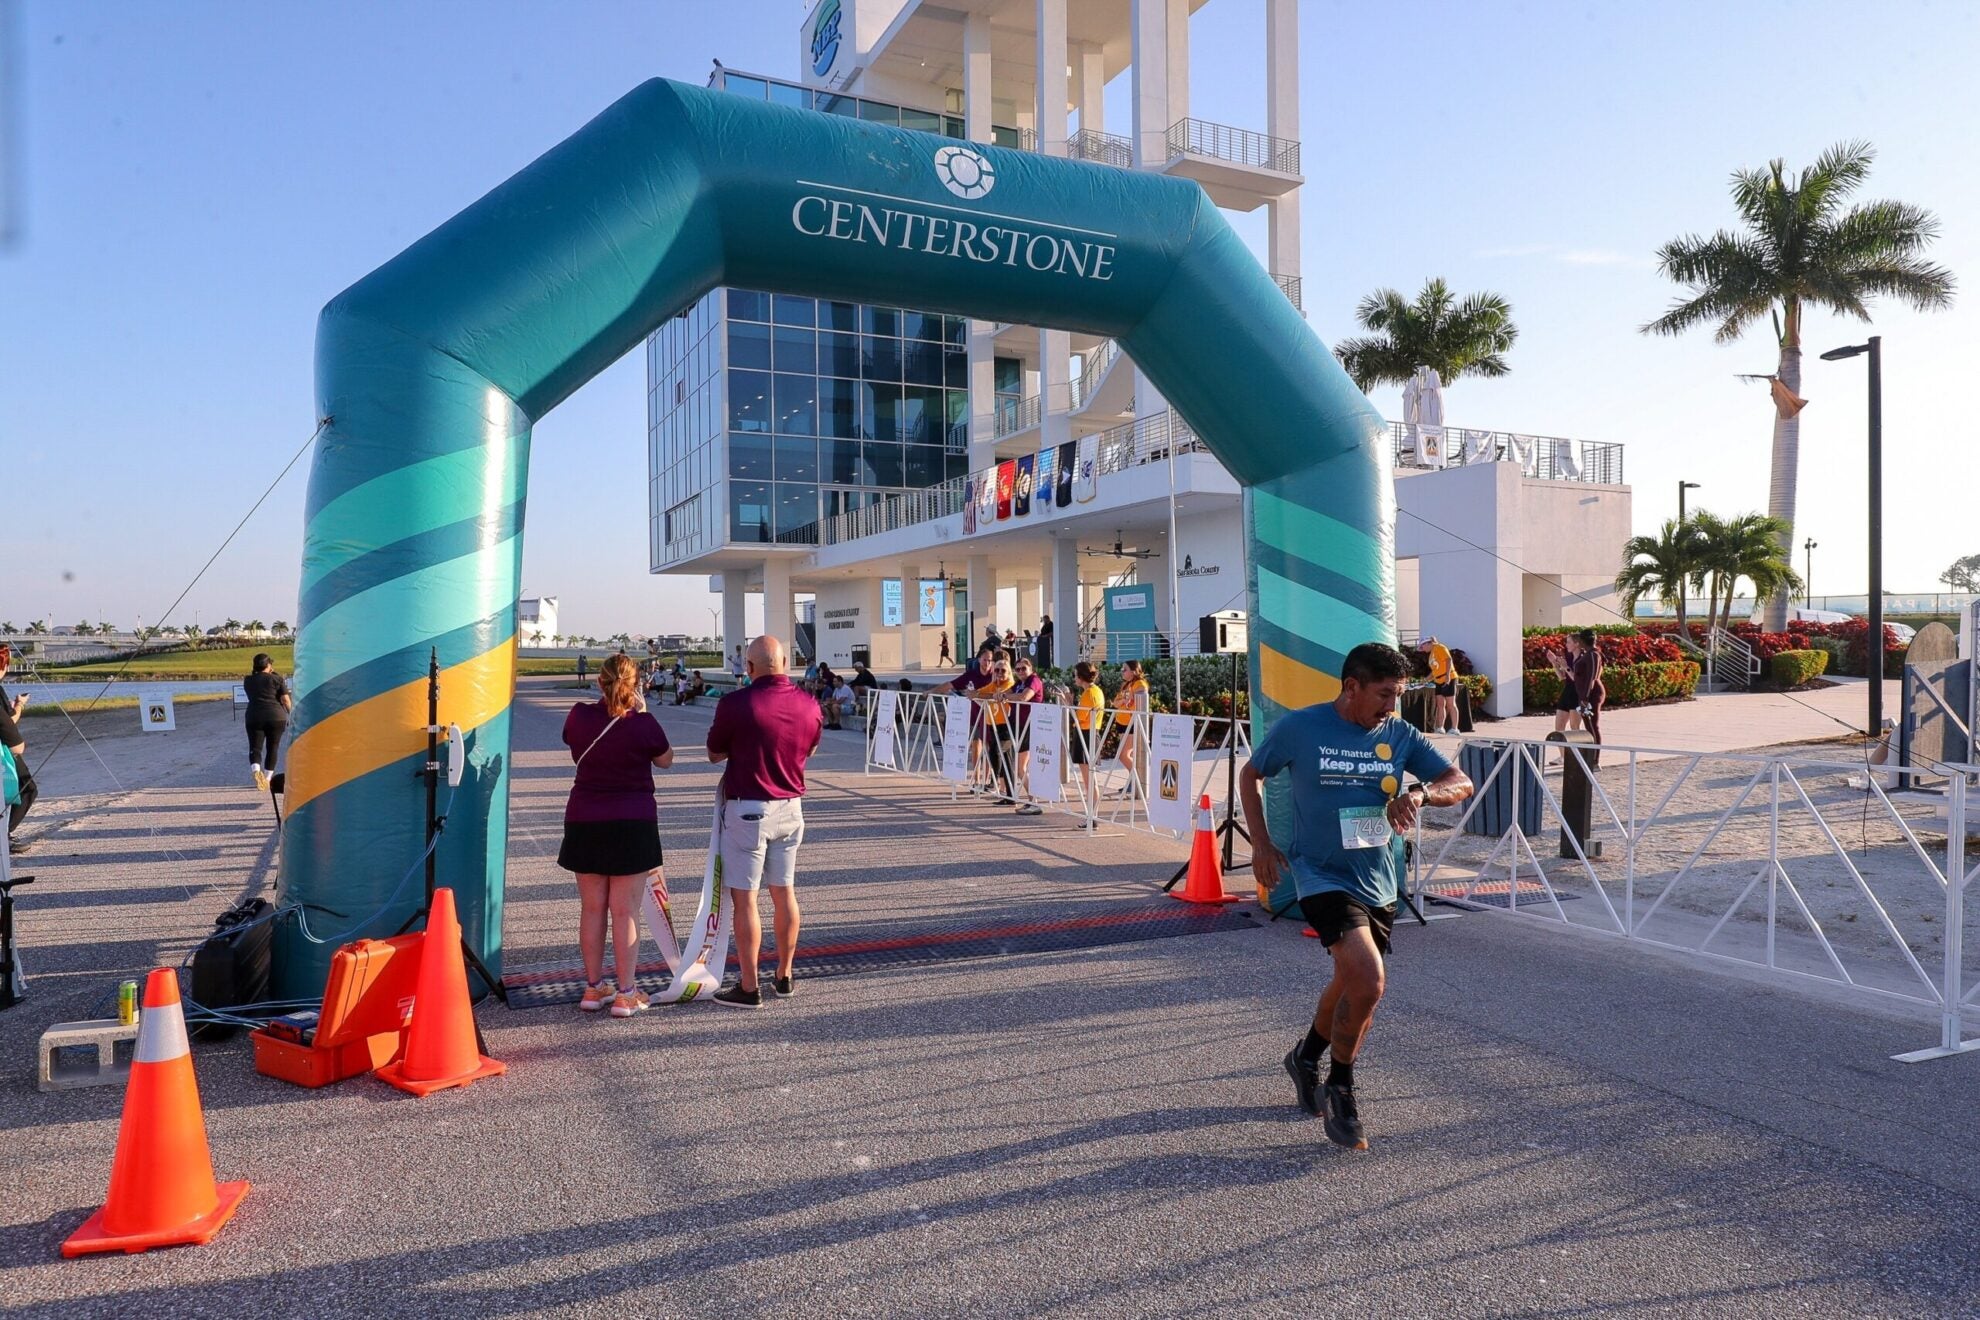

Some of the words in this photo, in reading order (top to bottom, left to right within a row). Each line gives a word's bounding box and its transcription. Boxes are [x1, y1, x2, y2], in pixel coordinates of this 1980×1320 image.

[792, 195, 1116, 281] CENTERSTONE
[1200, 564, 1220, 575] County
[1318, 745, 1339, 755] You
[1341, 748, 1376, 759] matter.
[1319, 757, 1355, 773] Keep
[1358, 760, 1396, 774] going.
[1350, 816, 1385, 838] 746
